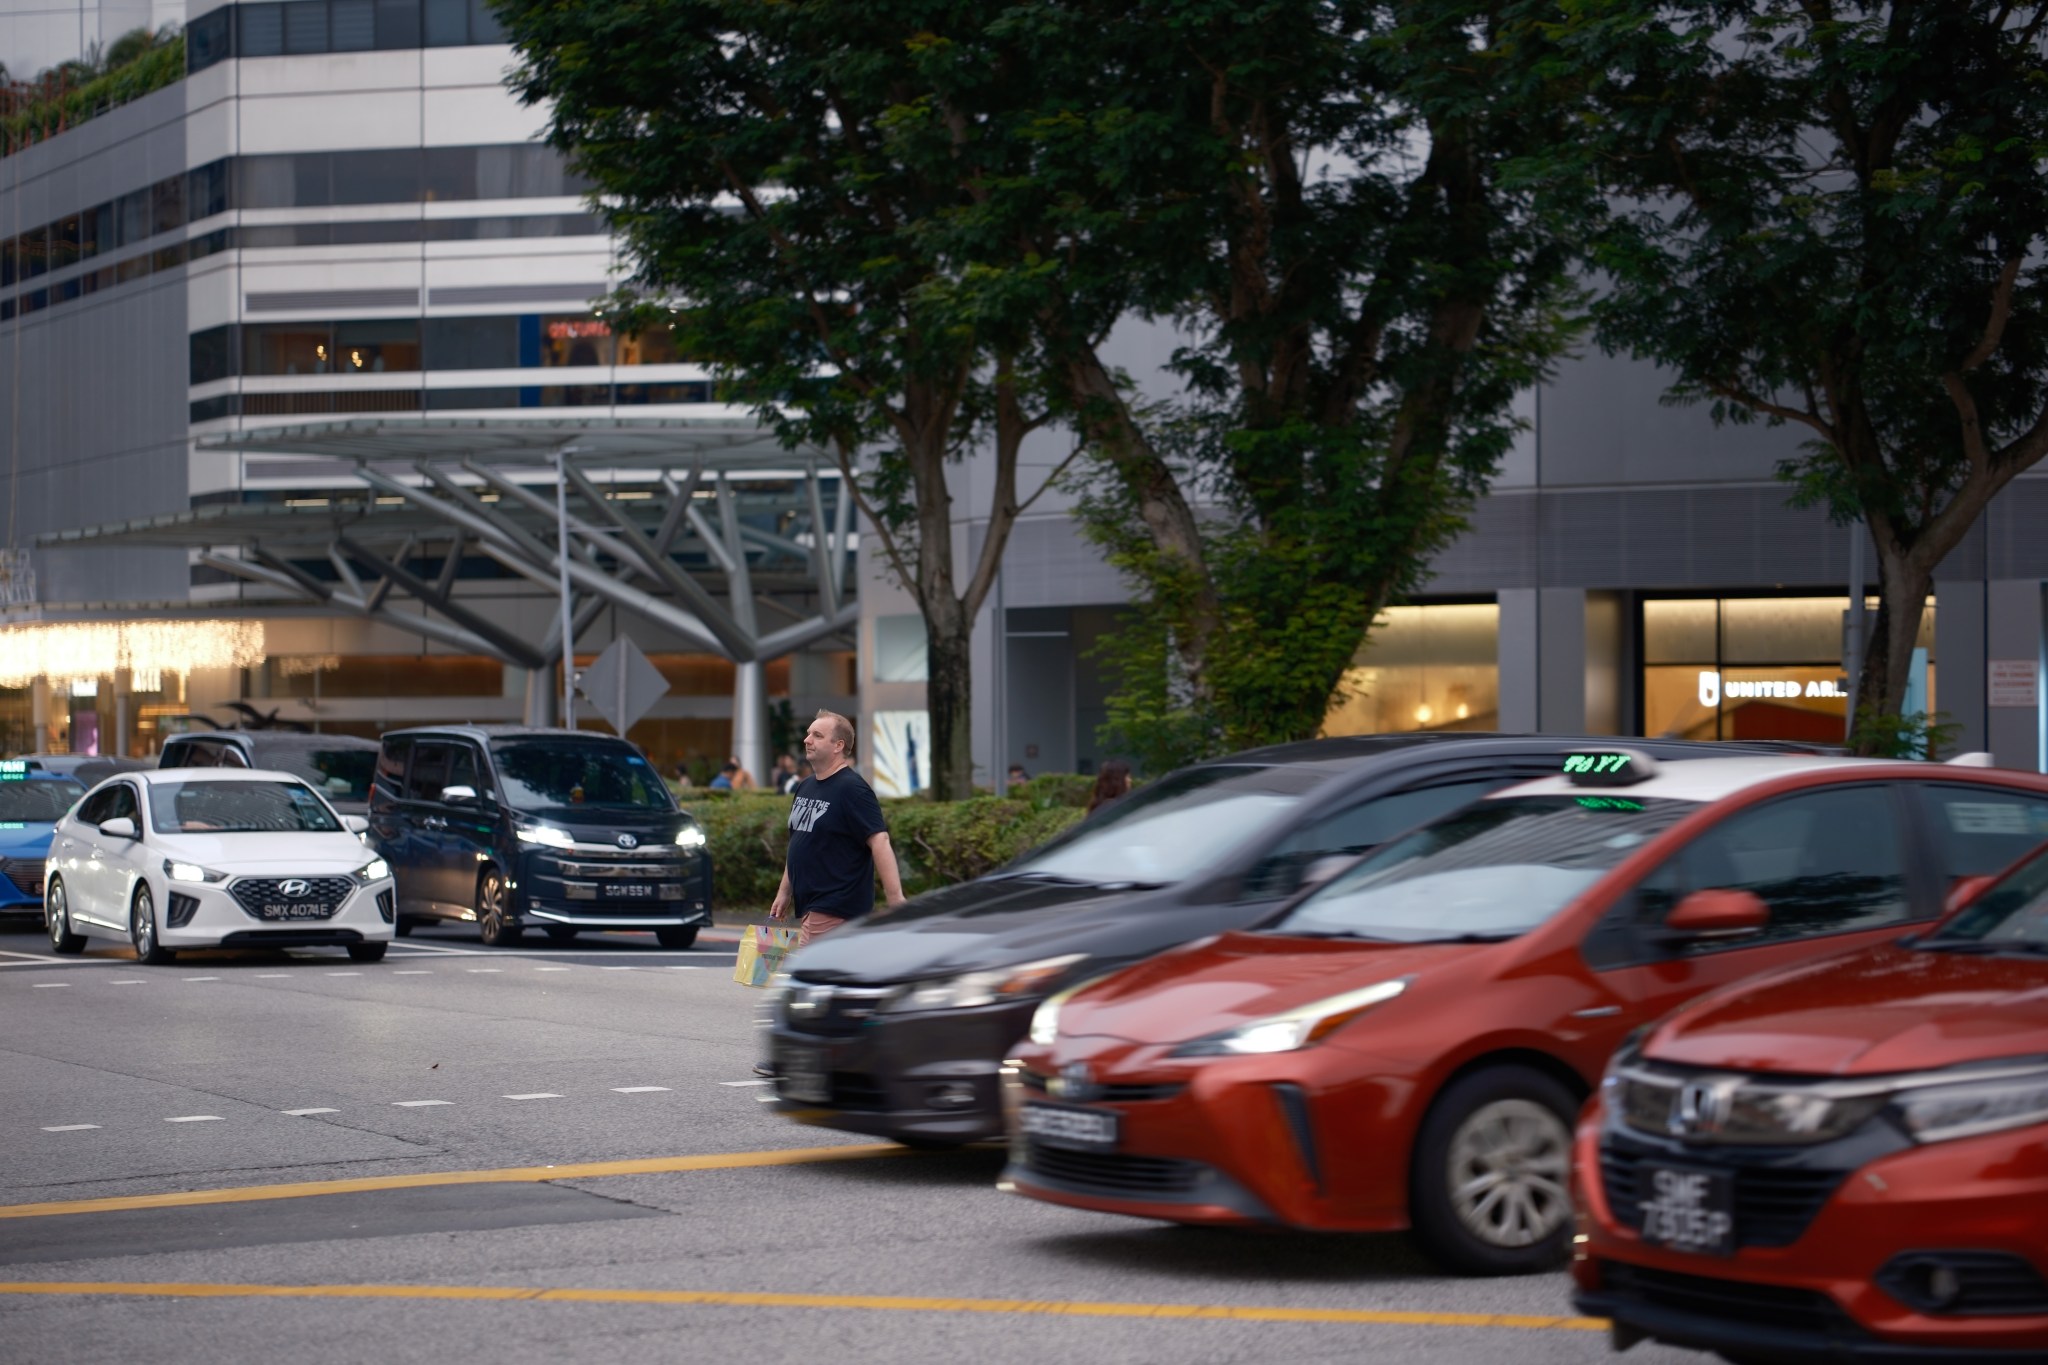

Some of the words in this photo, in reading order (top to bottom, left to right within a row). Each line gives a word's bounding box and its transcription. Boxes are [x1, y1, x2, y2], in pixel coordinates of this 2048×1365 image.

[1725, 681, 1801, 698] UNITED
[794, 797, 808, 807] THIS
[807, 799, 815, 808] IS
[814, 800, 830, 811] THE
[788, 805, 827, 832] WAY
